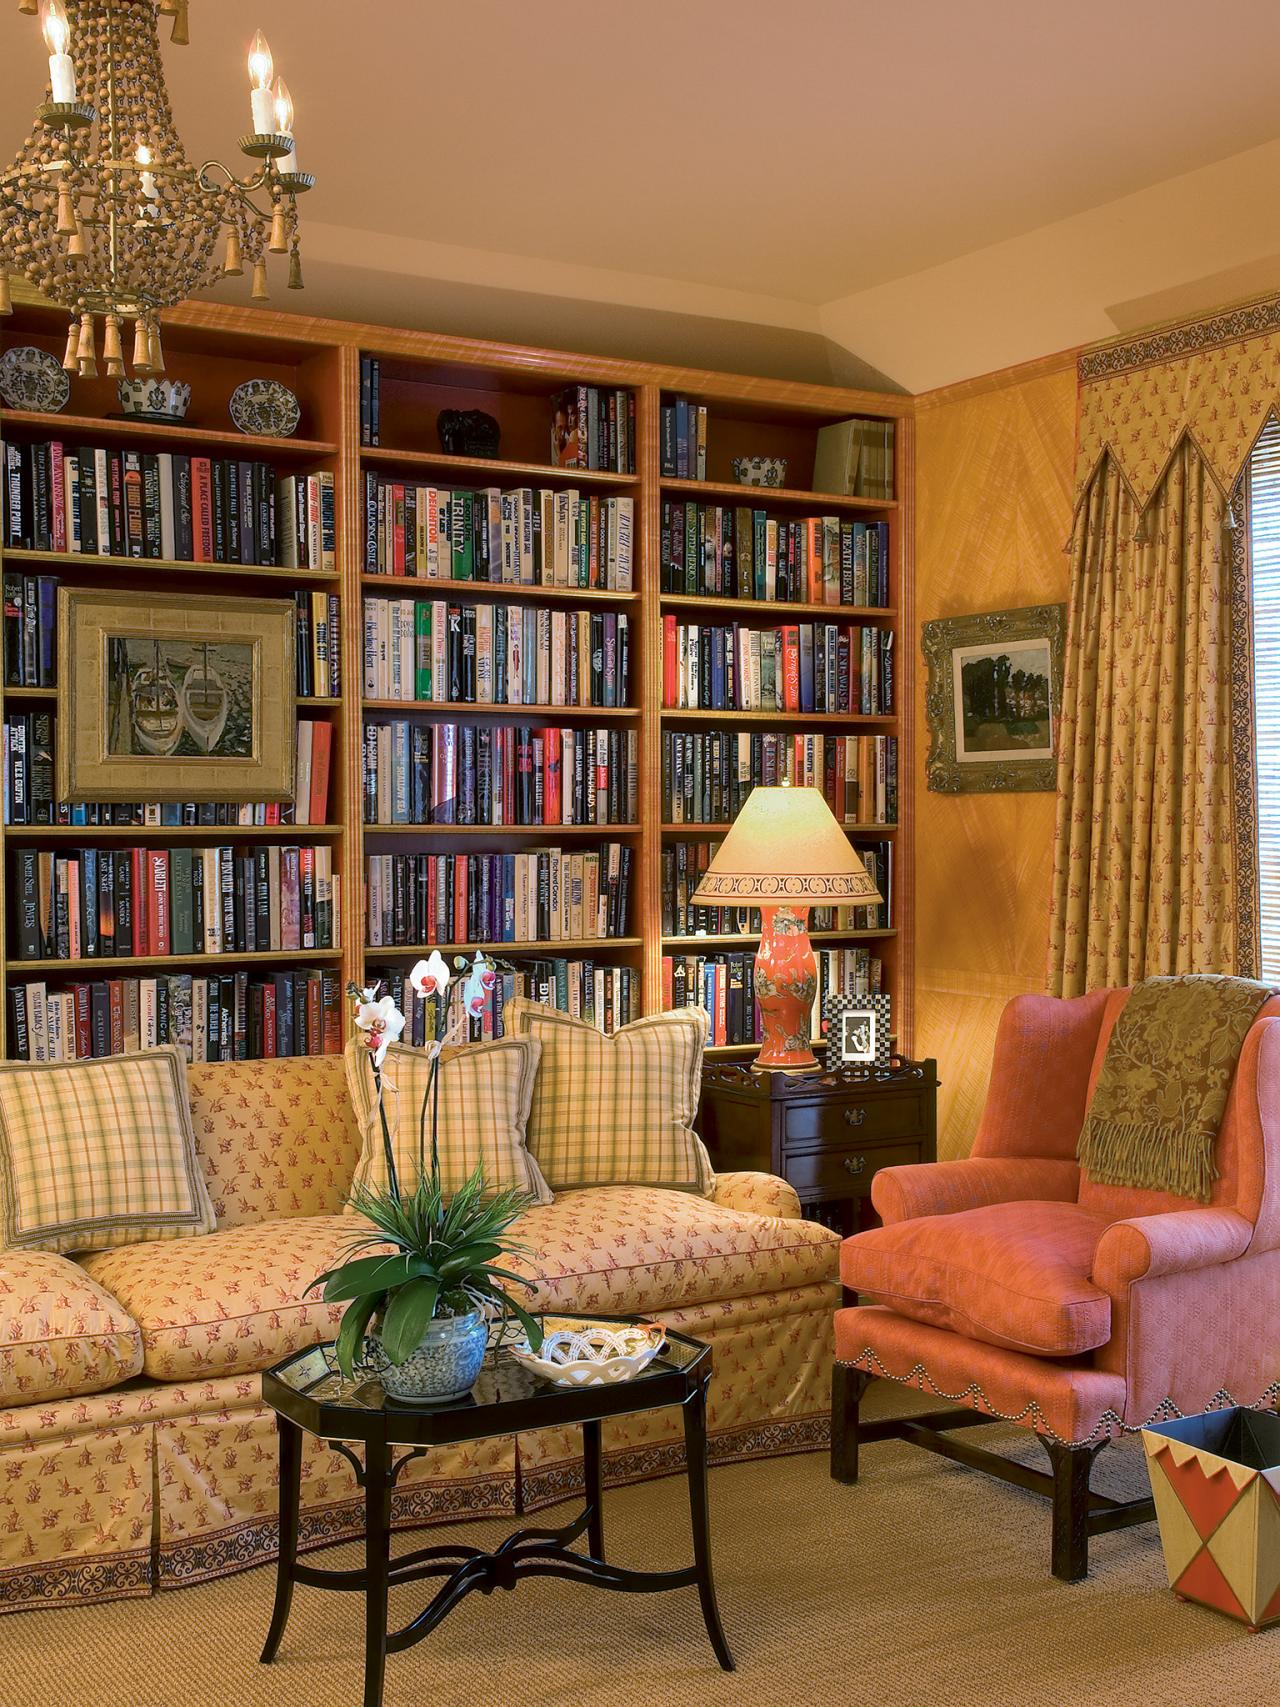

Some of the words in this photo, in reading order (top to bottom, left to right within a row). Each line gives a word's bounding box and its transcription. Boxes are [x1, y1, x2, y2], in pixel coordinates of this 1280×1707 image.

[11, 473, 21, 511] THUNDER
[128, 486, 140, 506] HIGH
[200, 482, 208, 501] PLACE
[12, 512, 21, 536] POINT
[130, 509, 142, 540] FLIGHT
[453, 498, 463, 552] TRINITY
[202, 528, 210, 557] FREEDOM
[843, 535, 852, 568] DEATH
[844, 570, 853, 602] BEAM
[317, 622, 326, 644] STONE
[317, 646, 326, 662] CITY
[10, 727, 18, 751] ATTACK
[367, 726, 377, 740] ED
[16, 780, 24, 804] GRIFFIN
[32, 766, 42, 800] MIDNIGHT
[222, 850, 232, 861] THE
[101, 874, 109, 892] NIGHT
[153, 857, 166, 892] SCARLETT
[22, 900, 36, 928] JEWELS
[15, 991, 24, 1022] WINTER
[32, 992, 42, 1010] SUSAN
[66, 998, 74, 1034] CINNAMON
[16, 1024, 26, 1052] PALACE
